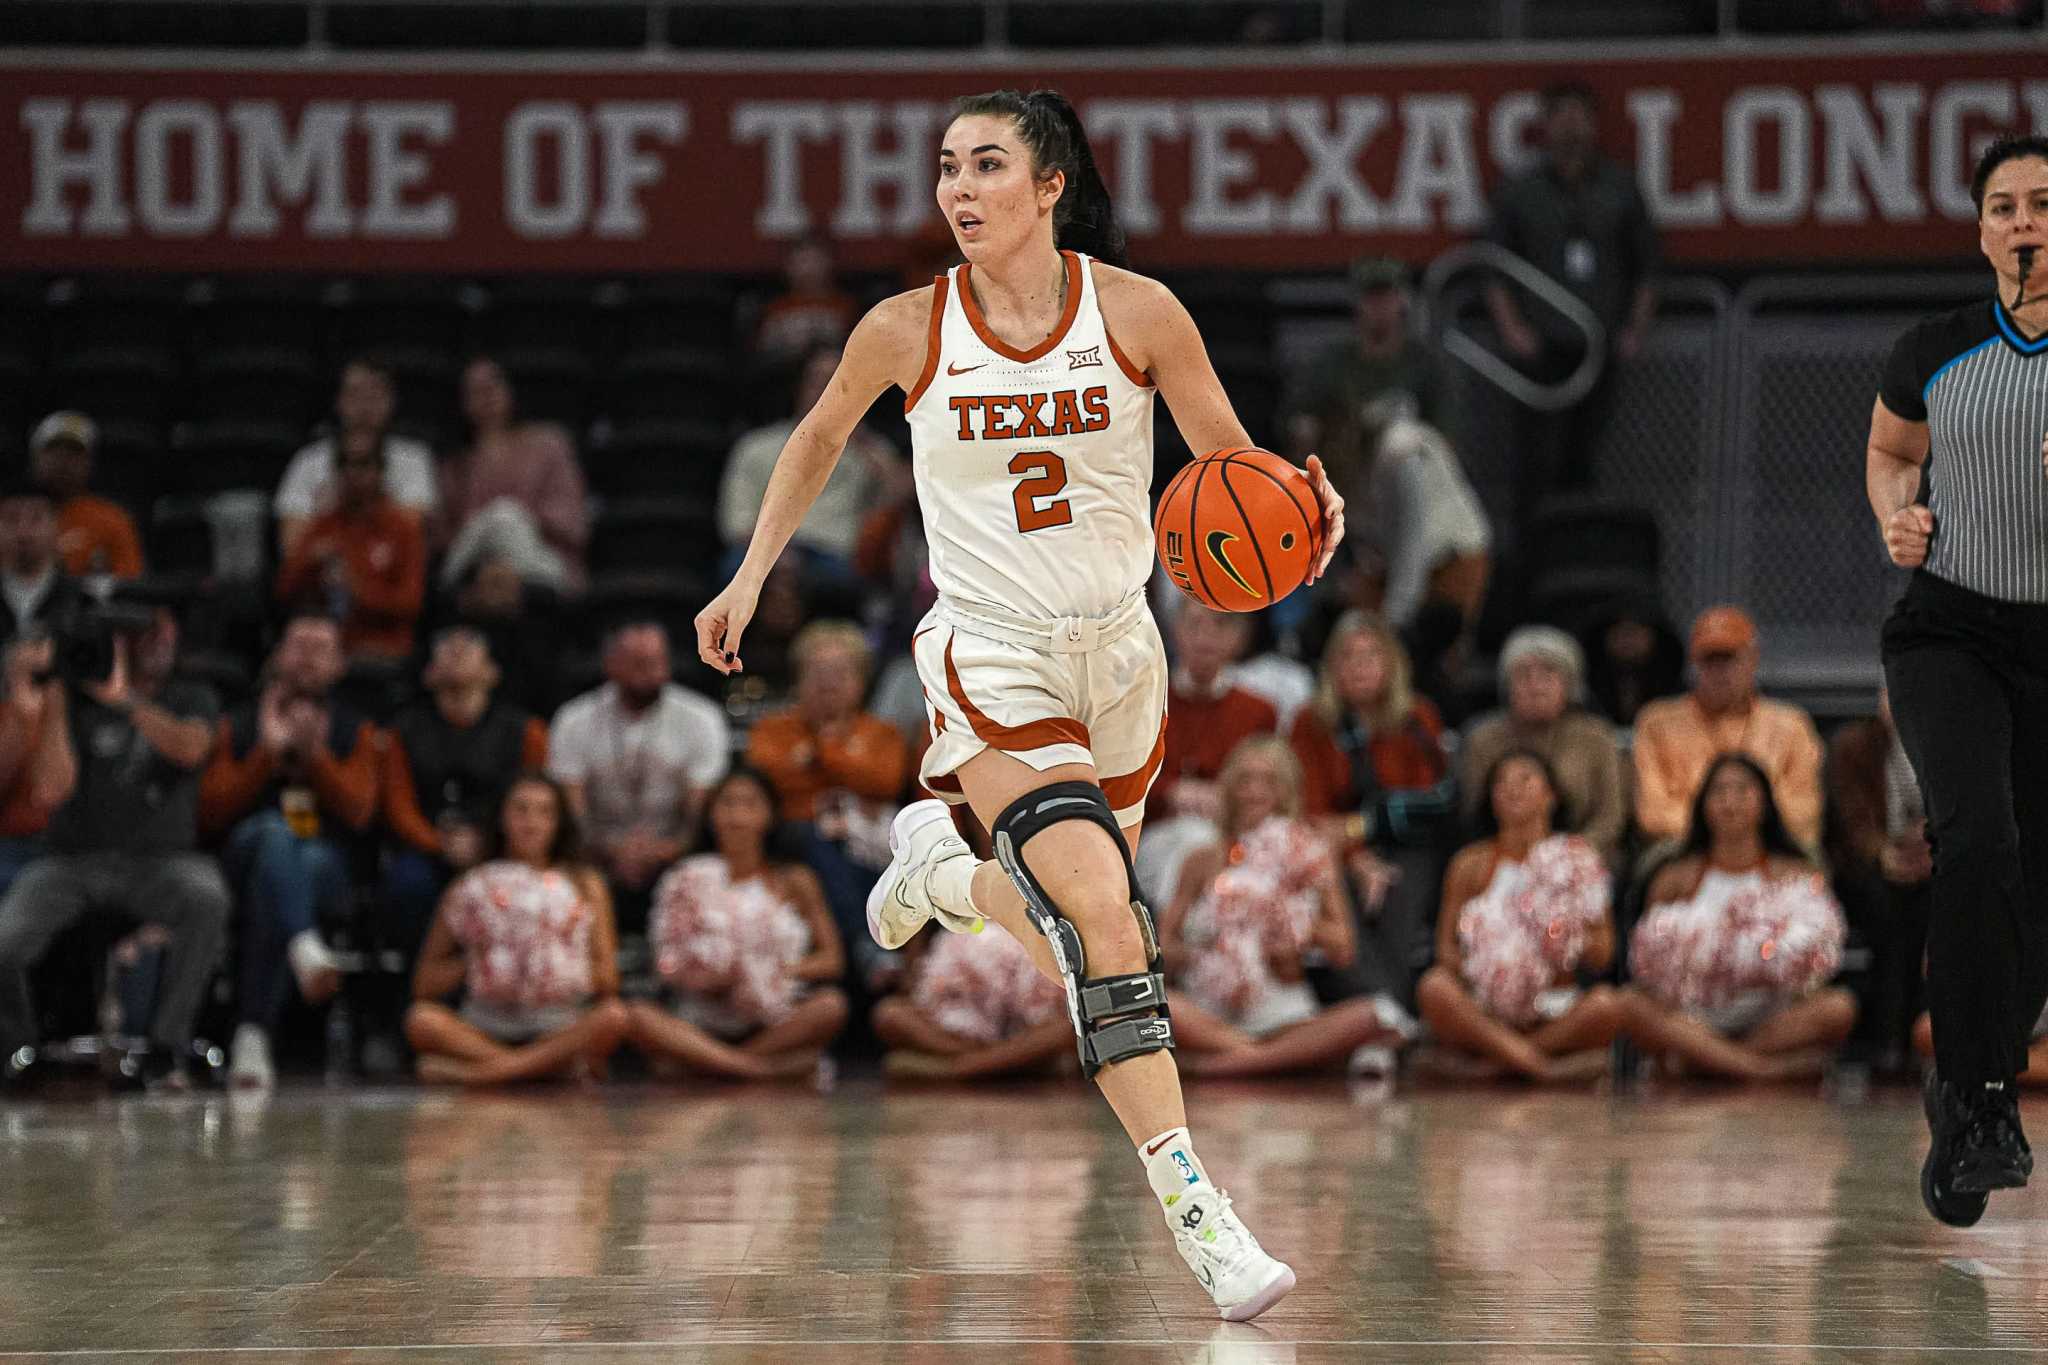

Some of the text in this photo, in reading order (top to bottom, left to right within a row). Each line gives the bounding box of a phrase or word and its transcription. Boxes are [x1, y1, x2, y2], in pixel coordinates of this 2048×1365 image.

[20, 98, 457, 239] HOME
[503, 98, 690, 238] OF
[731, 98, 952, 238] TH
[1624, 82, 2048, 224] LONG
[949, 385, 1111, 441] TEXAS
[1008, 450, 1072, 533] 2
